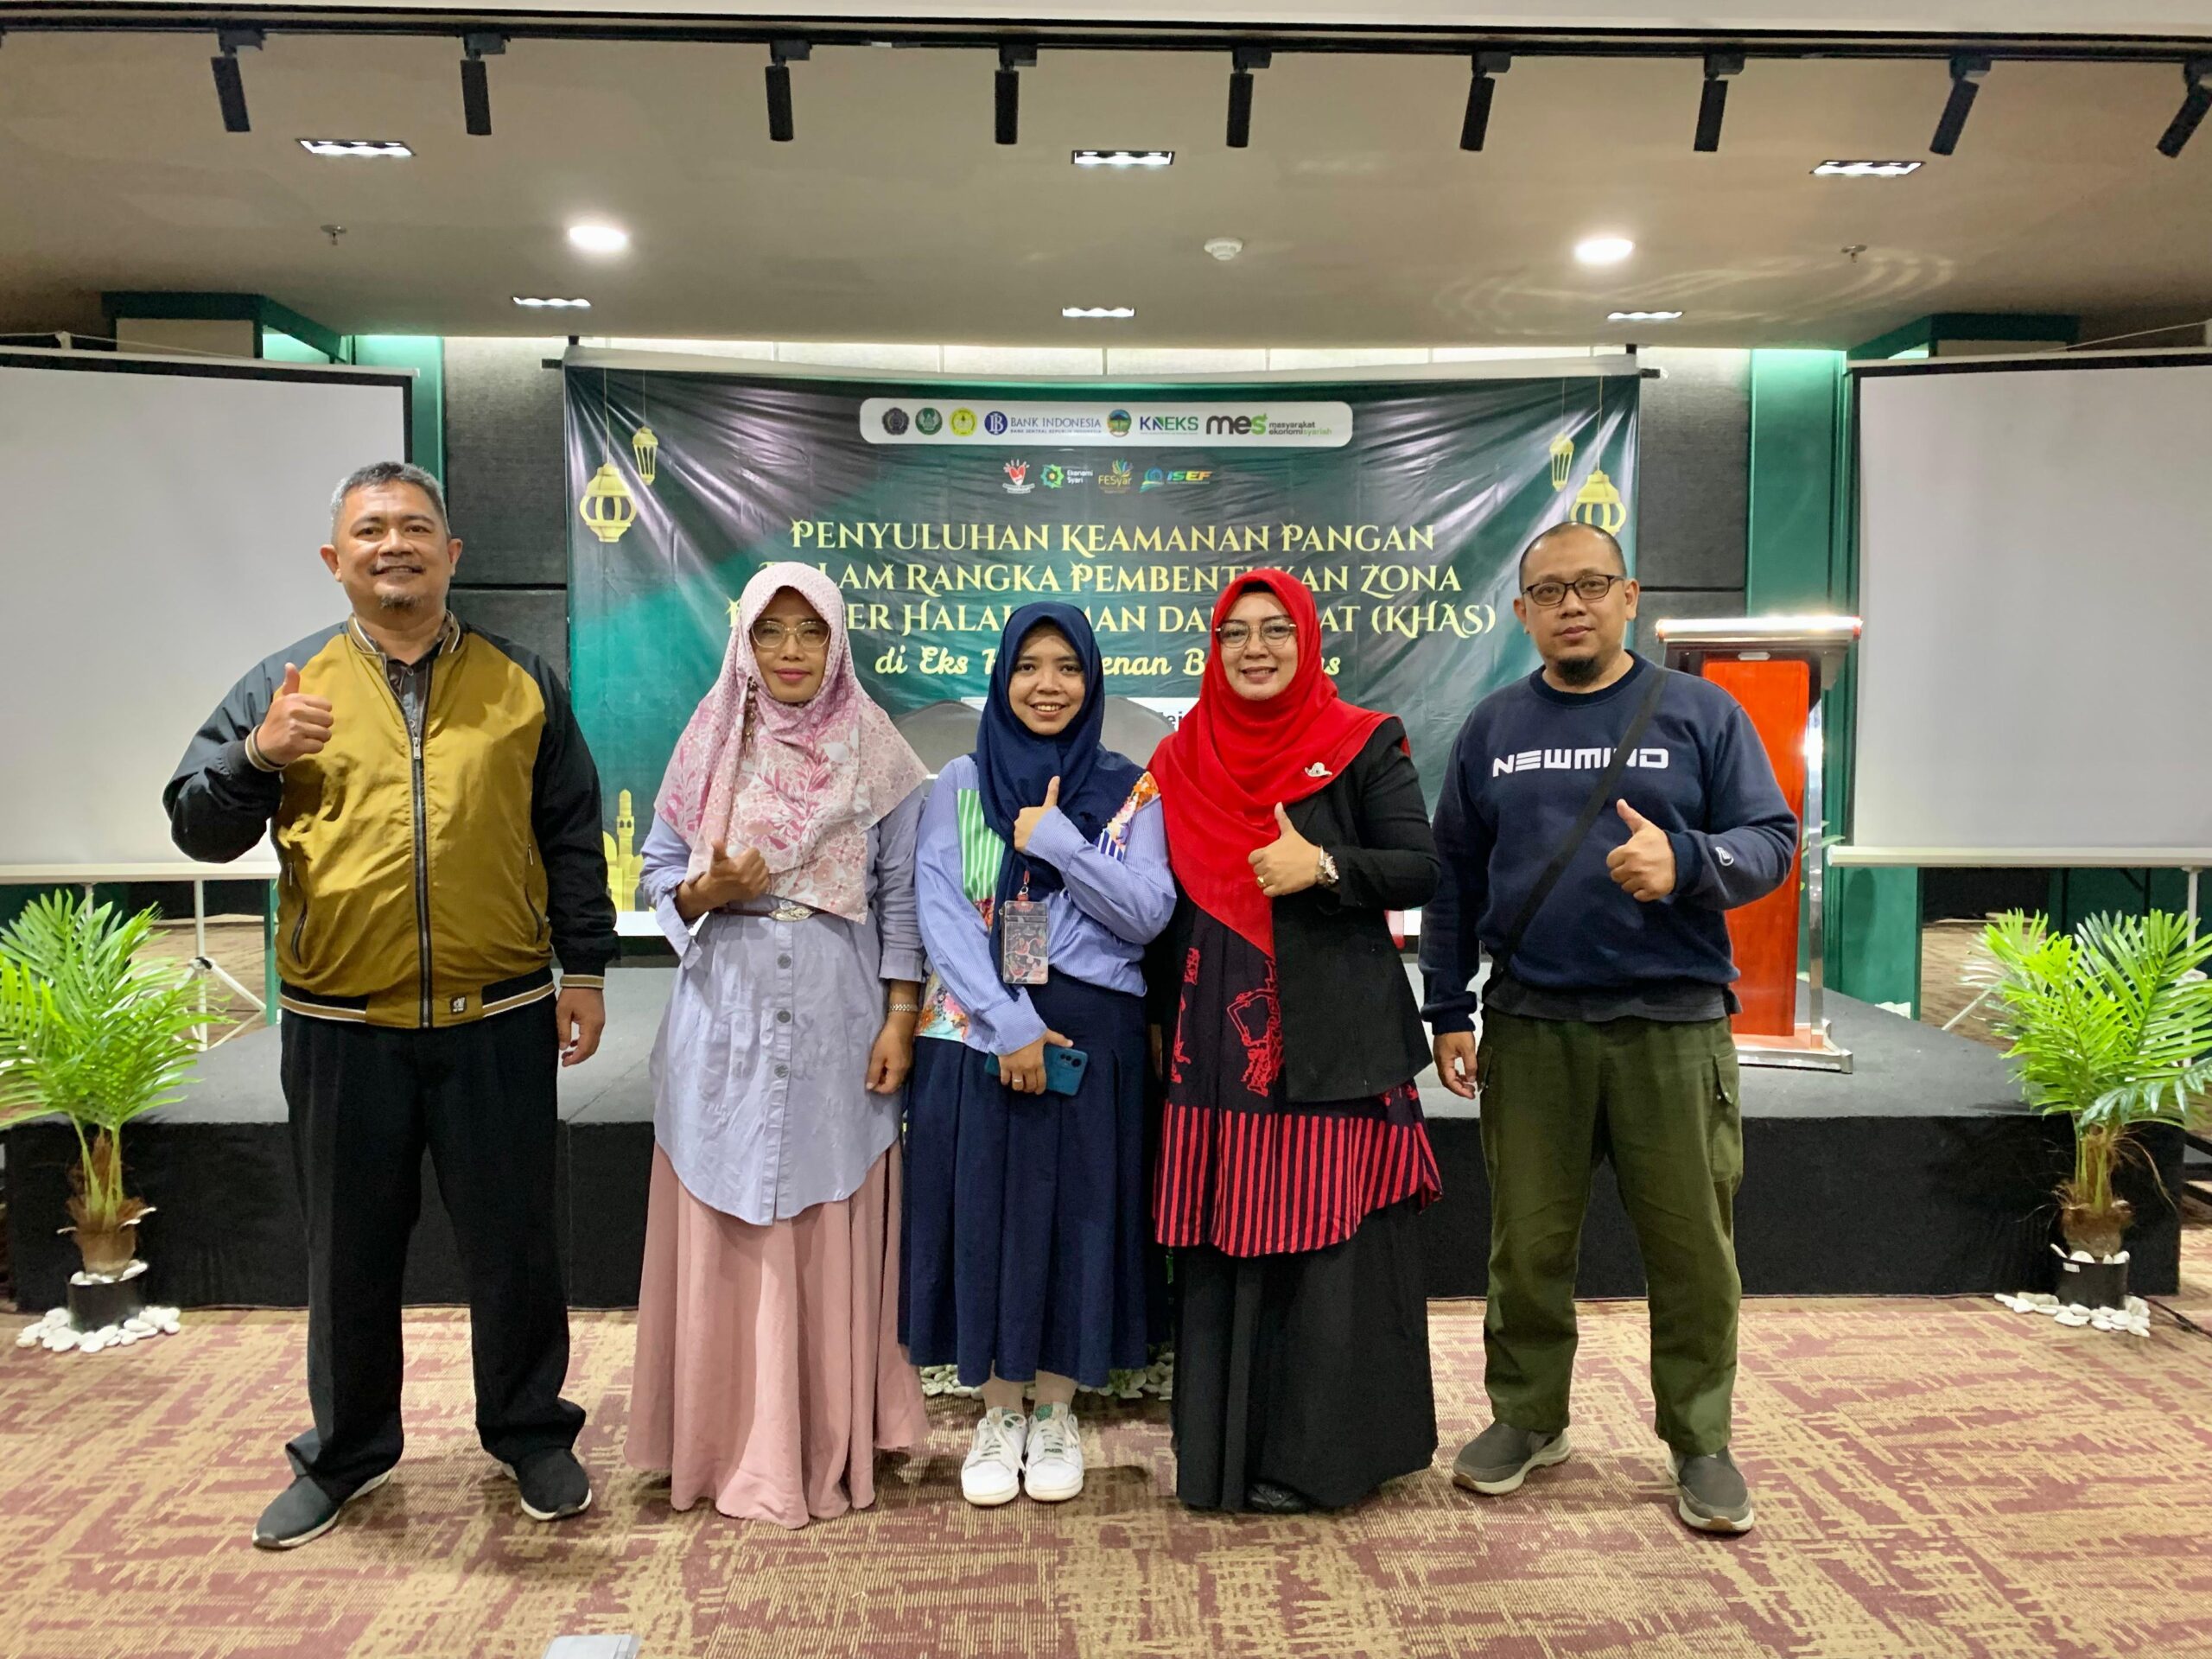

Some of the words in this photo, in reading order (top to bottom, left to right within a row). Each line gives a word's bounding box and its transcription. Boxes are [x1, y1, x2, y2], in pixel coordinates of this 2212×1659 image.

[1010, 417, 1039, 427] BANK
[1042, 417, 1102, 429] INDONESIA
[1140, 416, 1198, 430] KNEKS
[1206, 413, 1268, 435] mes
[1268, 421, 1315, 429] masyarakat
[1098, 474, 1132, 487] FESyar
[791, 518, 1049, 550] PENYULUHAN
[1062, 524, 1269, 558] KEAMANAN
[1281, 521, 1435, 551] PANGAN
[907, 564, 1062, 597] RANGKA
[1070, 561, 1349, 592] PEMBENTAN
[1361, 563, 1462, 599] ZONA
[1159, 606, 1216, 632] DA
[1371, 600, 1497, 639] (KHAS)
[874, 645, 908, 674] di
[919, 645, 969, 675] Eks
